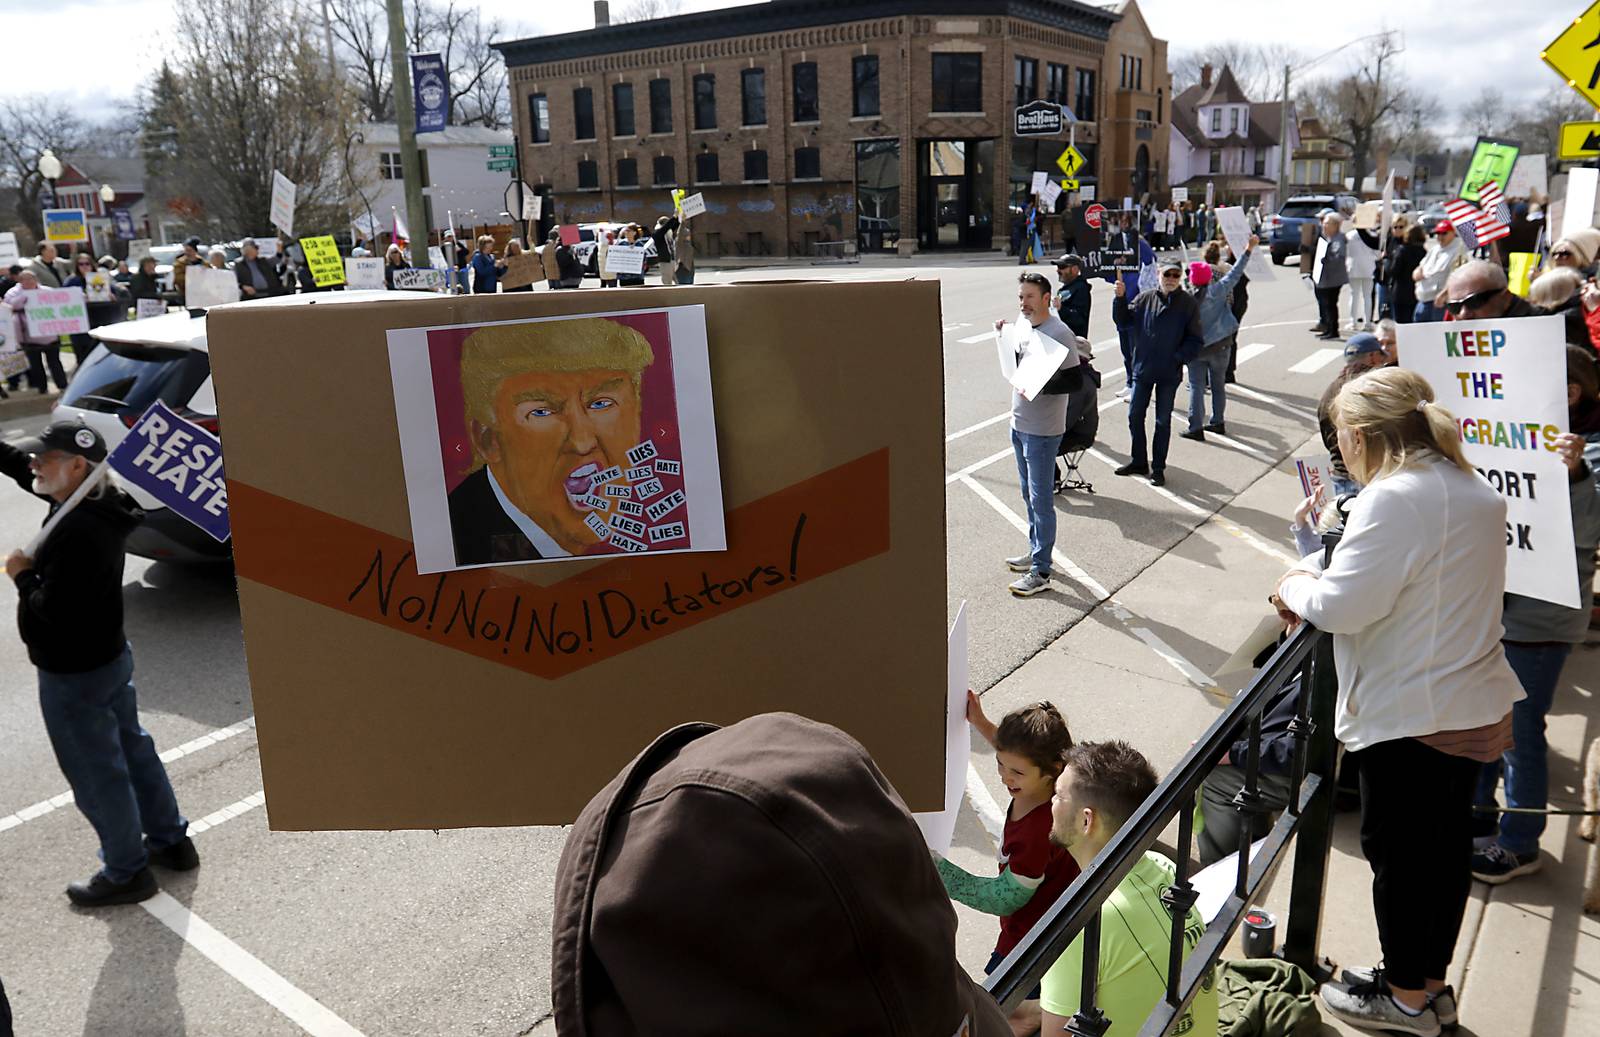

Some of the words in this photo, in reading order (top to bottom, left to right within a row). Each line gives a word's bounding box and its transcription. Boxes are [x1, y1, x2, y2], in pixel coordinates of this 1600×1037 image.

[1018, 110, 1059, 124] BratHaus
[1445, 330, 1506, 357] KEEP
[1456, 372, 1504, 399] THE
[629, 444, 654, 463] LIES
[628, 467, 651, 480] LIES
[656, 462, 678, 473] HATE
[132, 442, 228, 517] HATE
[594, 469, 619, 484] HATE
[607, 486, 630, 497] LIES
[638, 481, 661, 497] LIES
[586, 496, 607, 510] LIES
[620, 501, 641, 514] HATE
[649, 492, 684, 519] HATE
[587, 515, 608, 537] LIES
[611, 516, 643, 534] LIES
[651, 526, 683, 540] LIES
[611, 536, 643, 551] HATE
[598, 513, 807, 639] Dictators!
